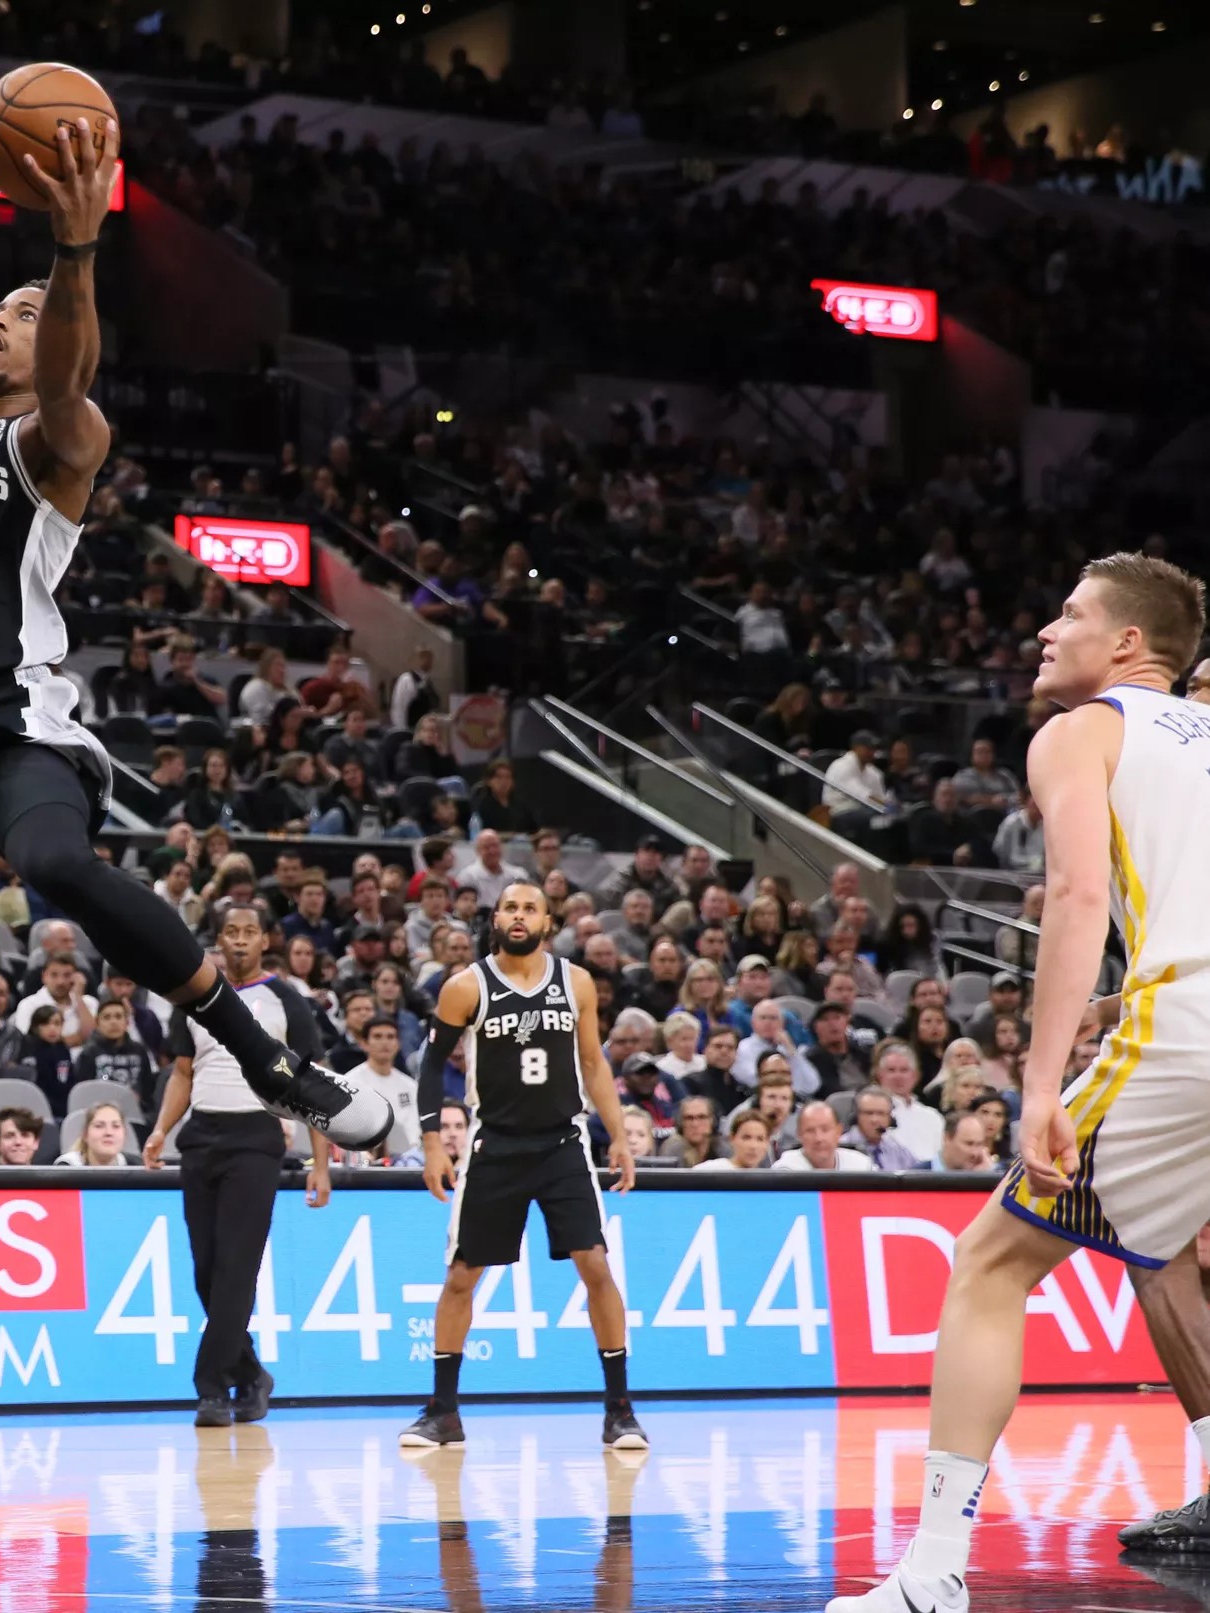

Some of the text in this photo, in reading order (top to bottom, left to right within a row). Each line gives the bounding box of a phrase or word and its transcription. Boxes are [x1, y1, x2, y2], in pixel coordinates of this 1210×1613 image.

[484, 1010, 574, 1045] SPURS
[521, 1048, 548, 1085] 8
[861, 1216, 1136, 1354] DAV
